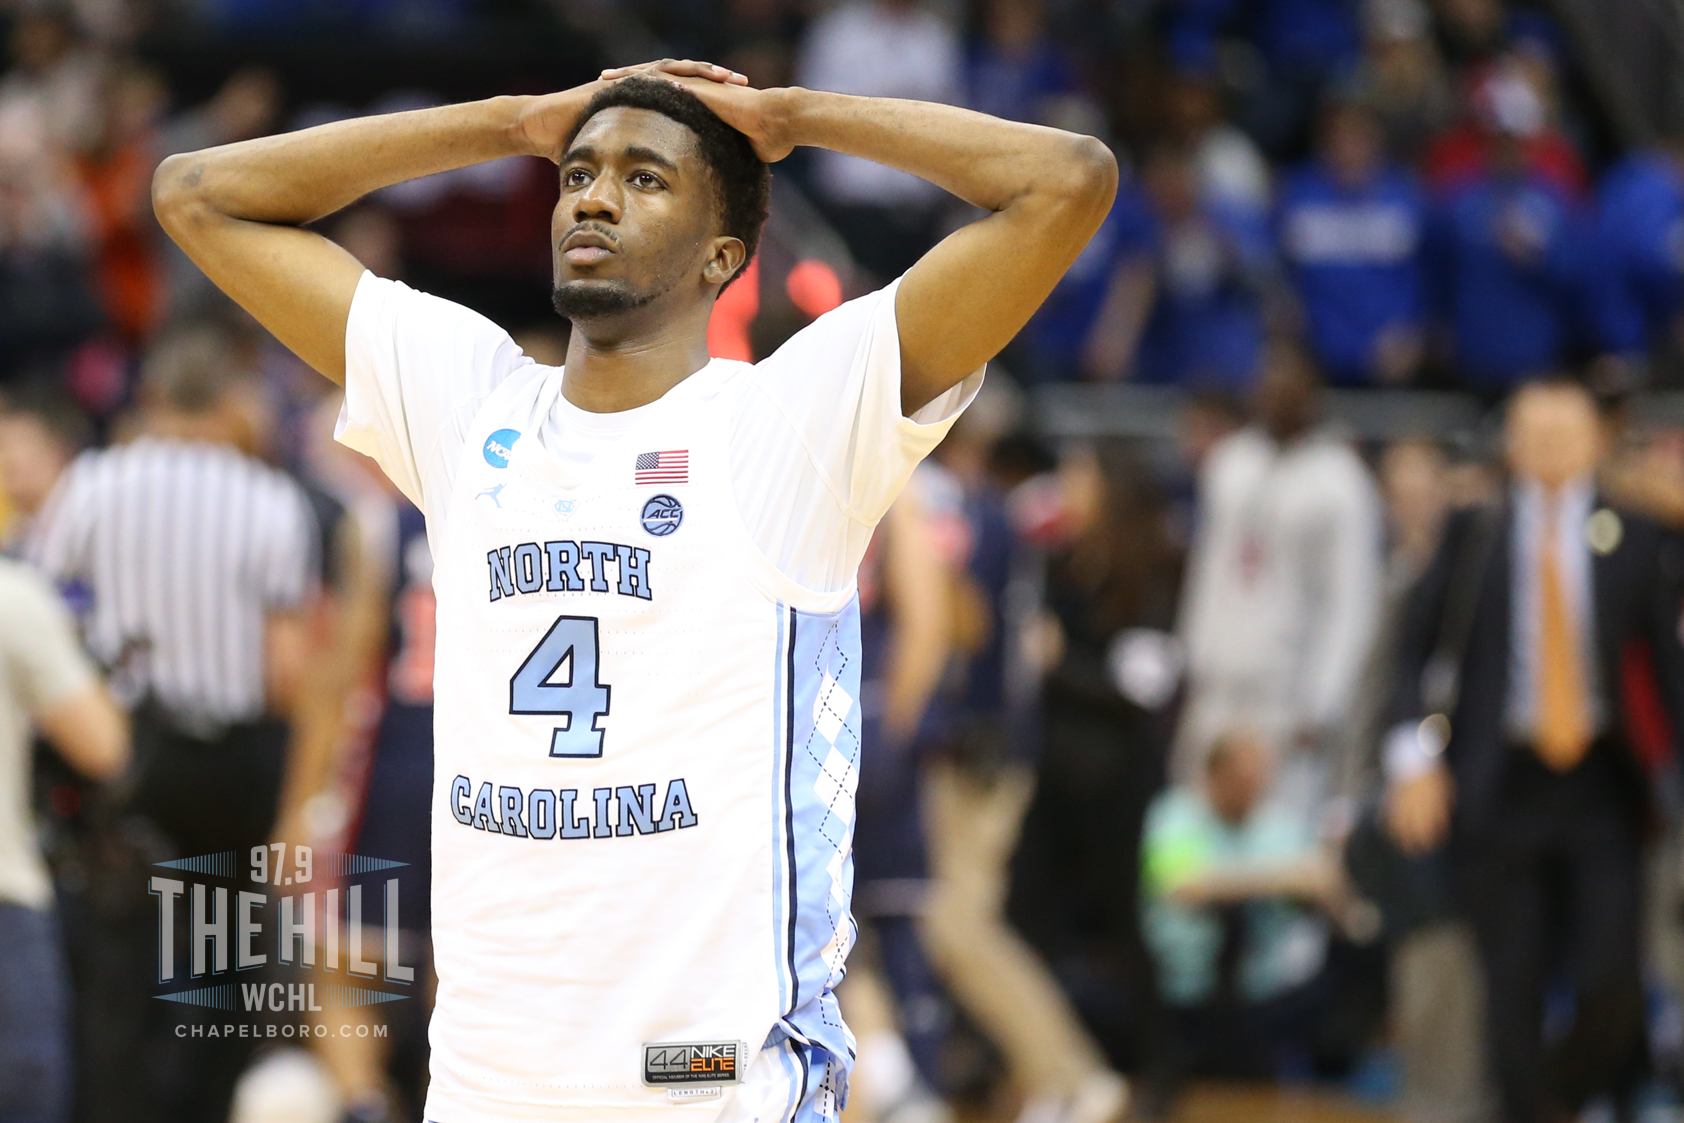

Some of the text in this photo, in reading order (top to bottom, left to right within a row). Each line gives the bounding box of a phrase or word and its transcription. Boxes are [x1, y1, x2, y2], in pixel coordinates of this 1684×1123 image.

[647, 508, 681, 519] ACC
[487, 540, 653, 603] NORTH
[509, 615, 612, 758] 4
[450, 774, 699, 840] CAROLINA
[650, 1049, 688, 1070] 44
[691, 1045, 735, 1058] NIKE
[691, 1057, 735, 1071] ELITE
